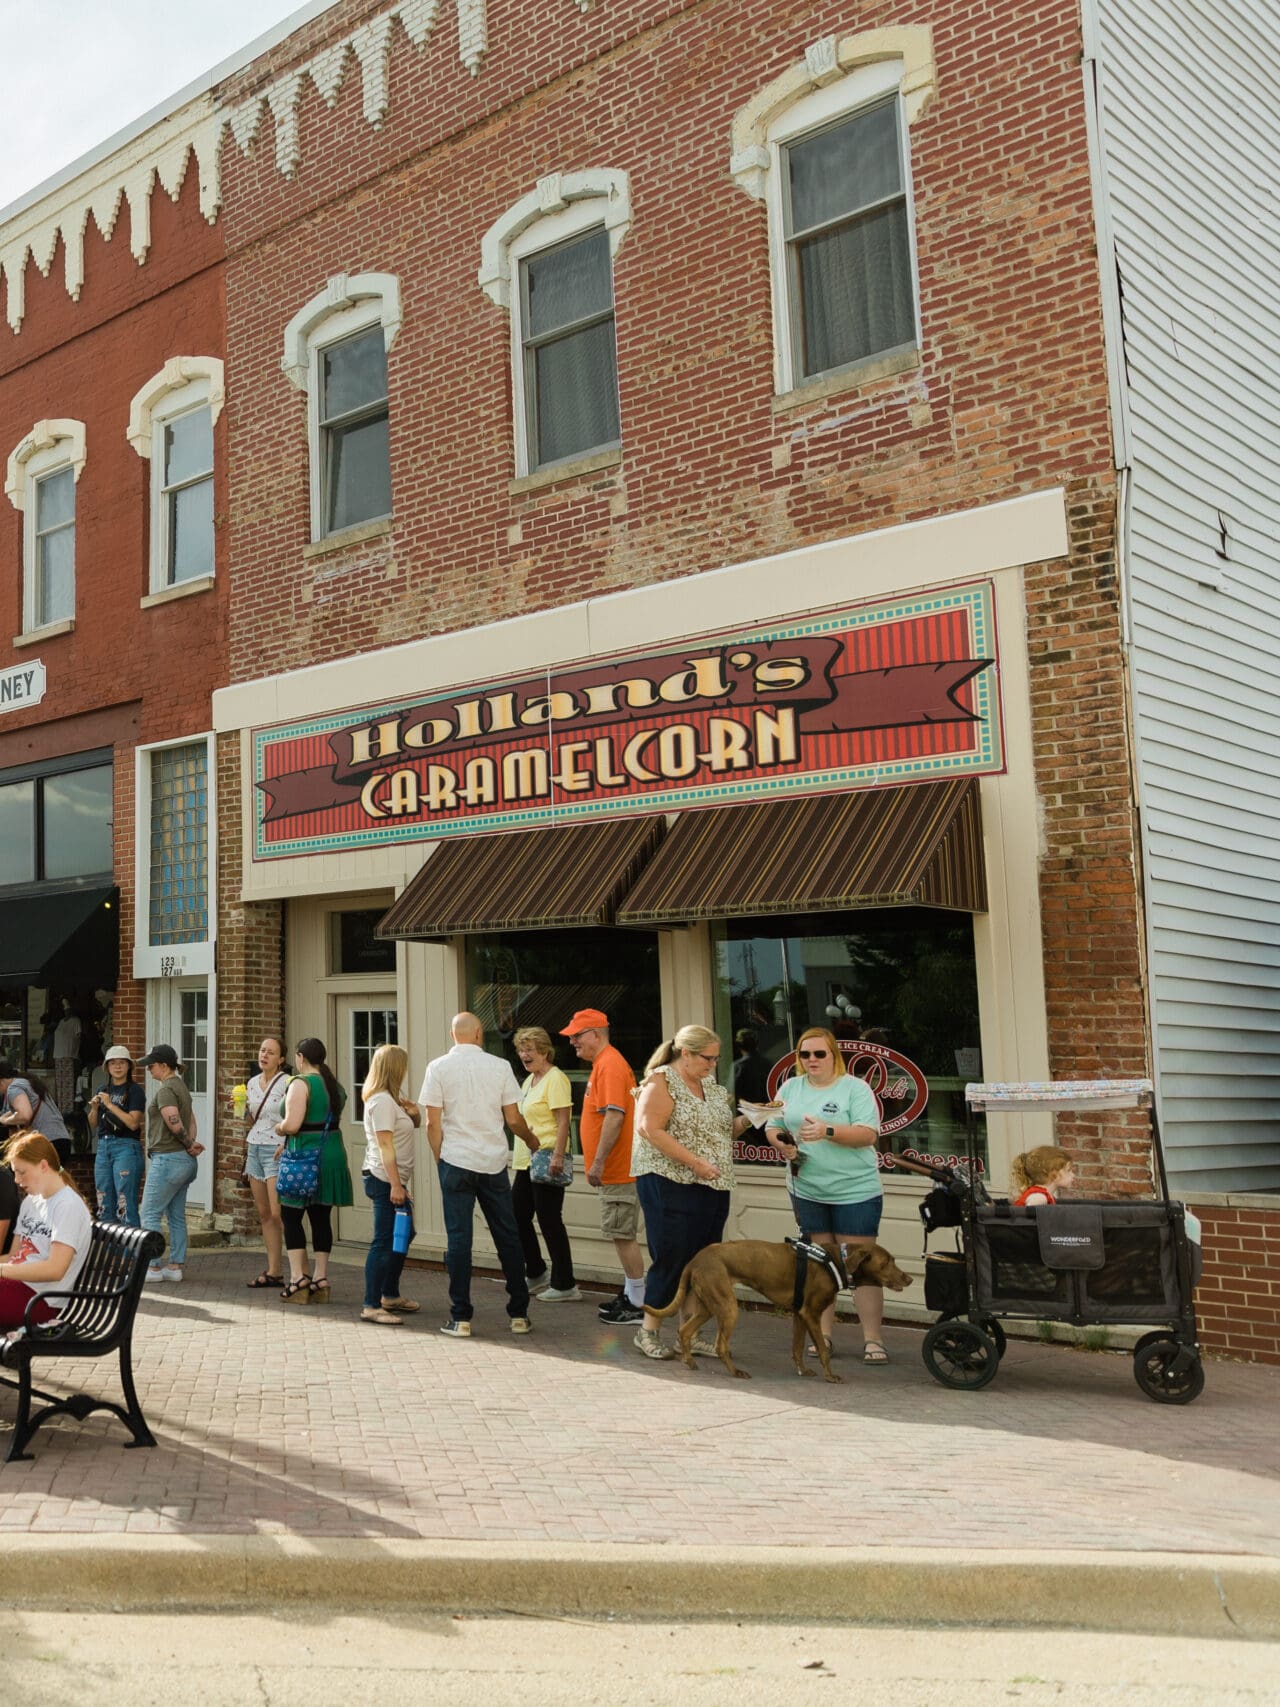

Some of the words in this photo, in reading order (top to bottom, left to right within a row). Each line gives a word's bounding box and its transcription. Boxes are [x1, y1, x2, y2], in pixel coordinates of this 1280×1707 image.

[349, 652, 809, 768] Holland's
[360, 705, 800, 820] CARAMELCORN
[161, 956, 175, 967] 123
[161, 966, 173, 977] 127
[844, 1042, 858, 1050] ICE
[859, 1044, 890, 1058] CREAM
[879, 1115, 909, 1134] LINOIS
